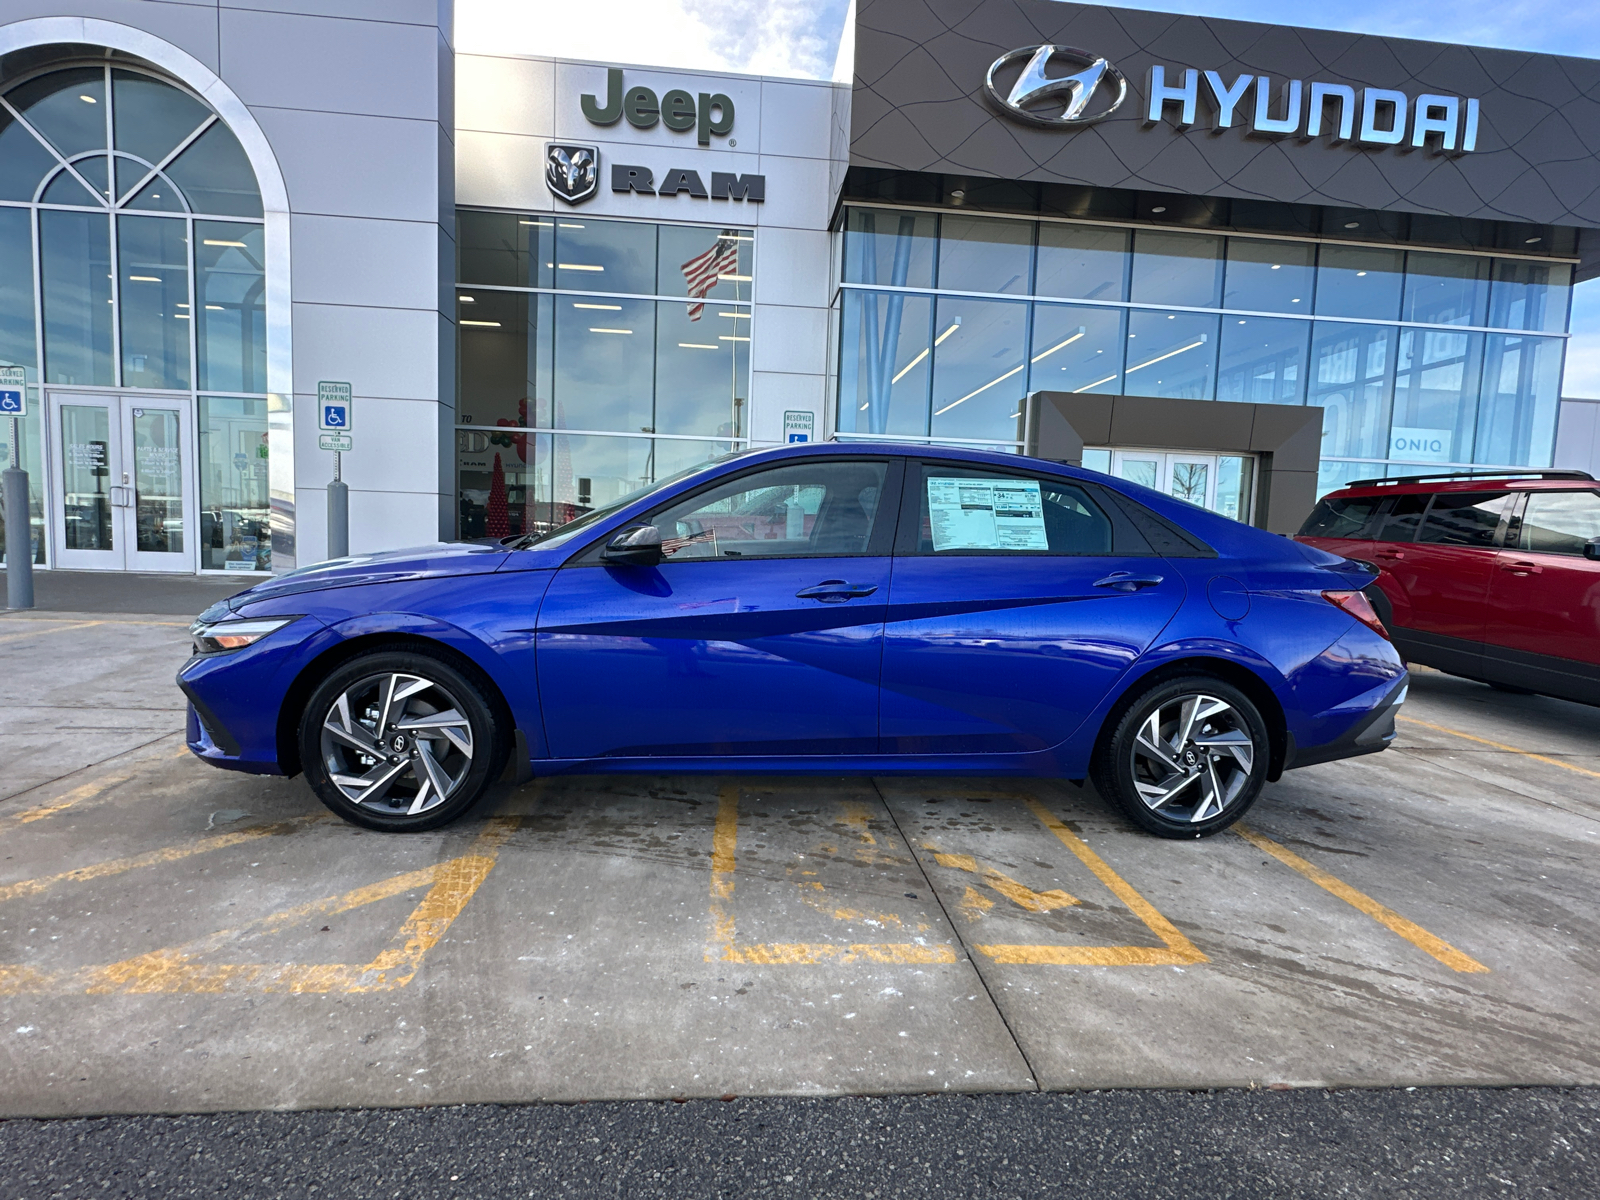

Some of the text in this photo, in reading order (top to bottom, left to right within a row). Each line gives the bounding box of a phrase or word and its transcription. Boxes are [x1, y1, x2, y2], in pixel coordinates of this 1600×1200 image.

[580, 68, 735, 145] Jeep
[1146, 65, 1480, 153] HYUNDAI
[611, 163, 766, 202] RAM
[0, 370, 22, 378] SERVED
[462, 415, 472, 423] TO
